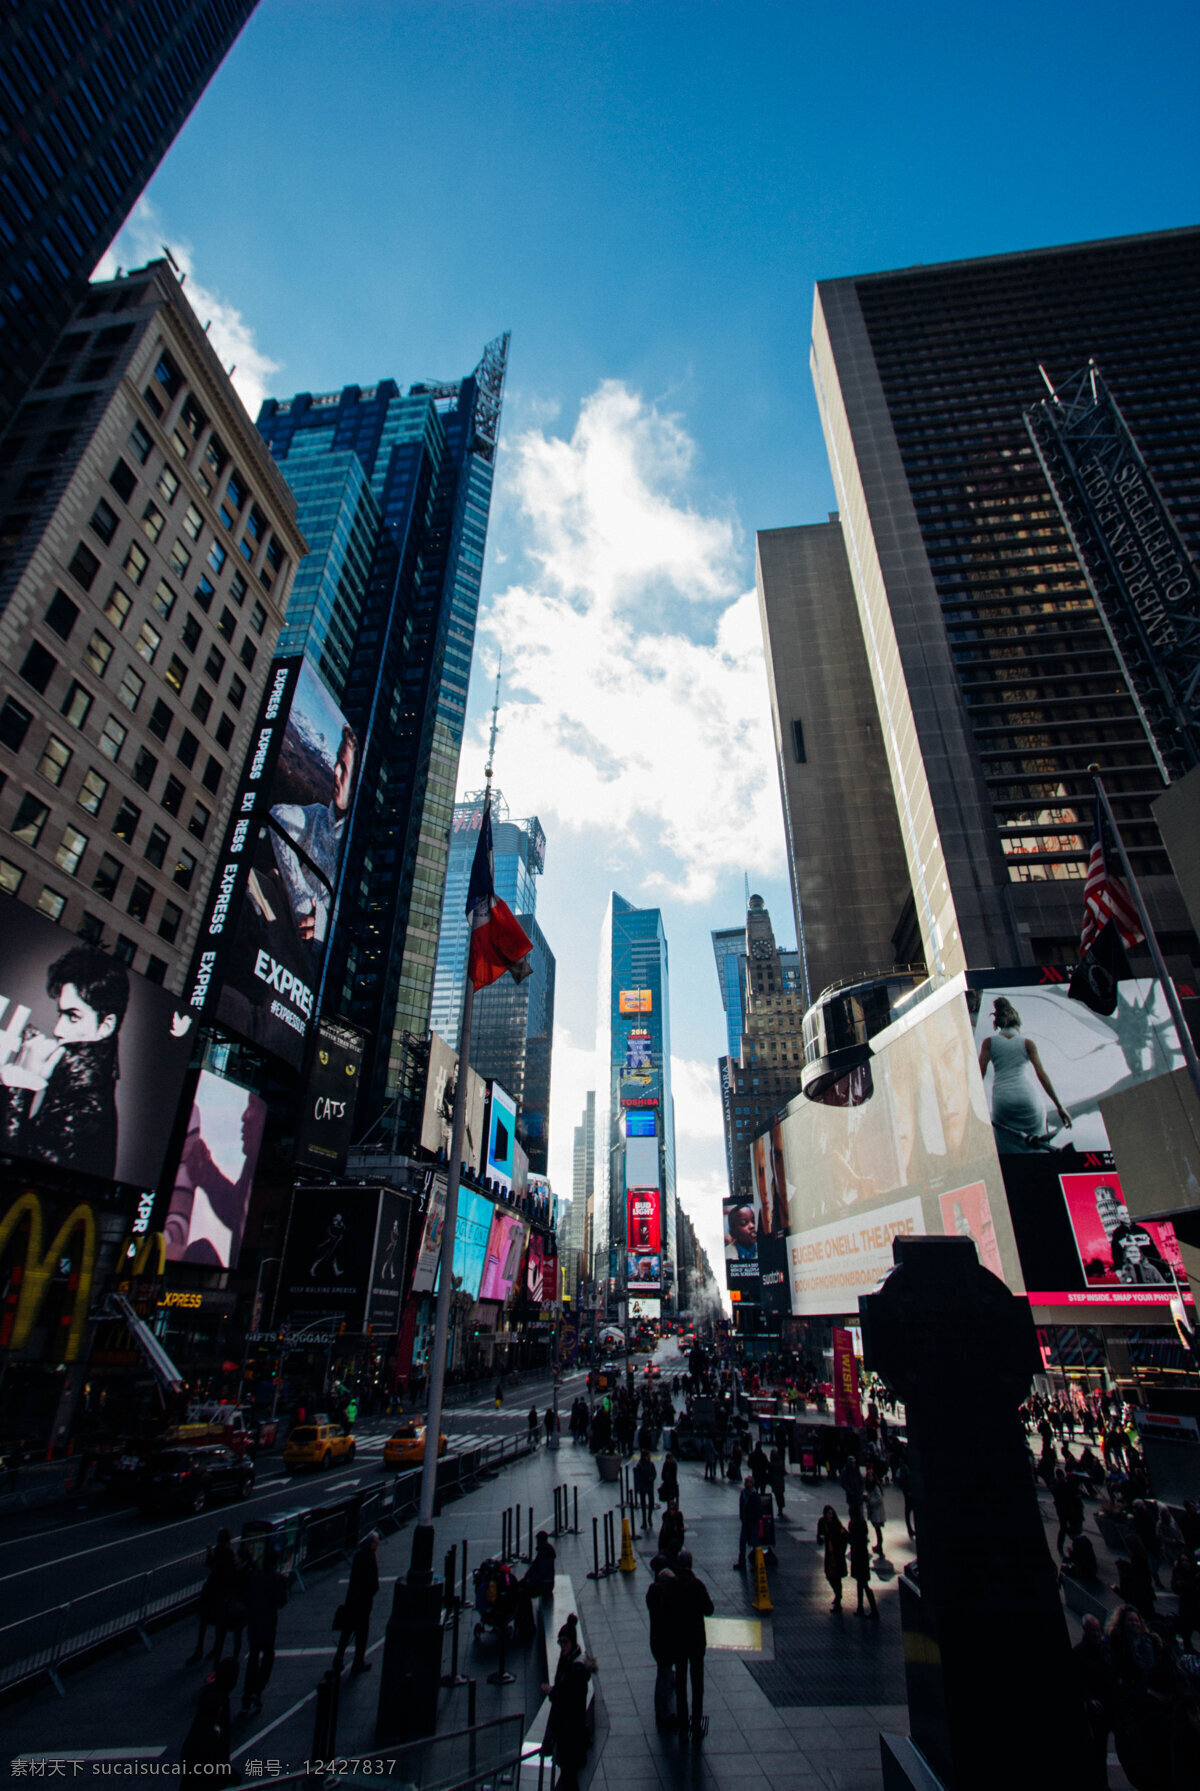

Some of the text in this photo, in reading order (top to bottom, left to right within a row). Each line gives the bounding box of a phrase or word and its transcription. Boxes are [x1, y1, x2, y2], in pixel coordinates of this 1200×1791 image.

[1078, 455, 1179, 648] AMERICAN EAGLE
[1114, 463, 1192, 602] OUTFITTERS
[265, 668, 289, 721] EXPRESS
[249, 727, 273, 781] EXPRESS
[208, 863, 239, 936] EXPRESS
[190, 951, 217, 1011] EXPRE
[314, 1096, 347, 1121] CATS
[621, 1098, 659, 1106] TOSHIBA
[632, 1208, 654, 1216] LIGHT
[634, 1201, 652, 1209] BUD
[792, 1242, 824, 1266] EUGENE
[1067, 1293, 1087, 1302] STEP
[1112, 1293, 1131, 1302] SNAP
[1132, 1293, 1153, 1302] YOUR
[841, 1353, 853, 1394] WISH
